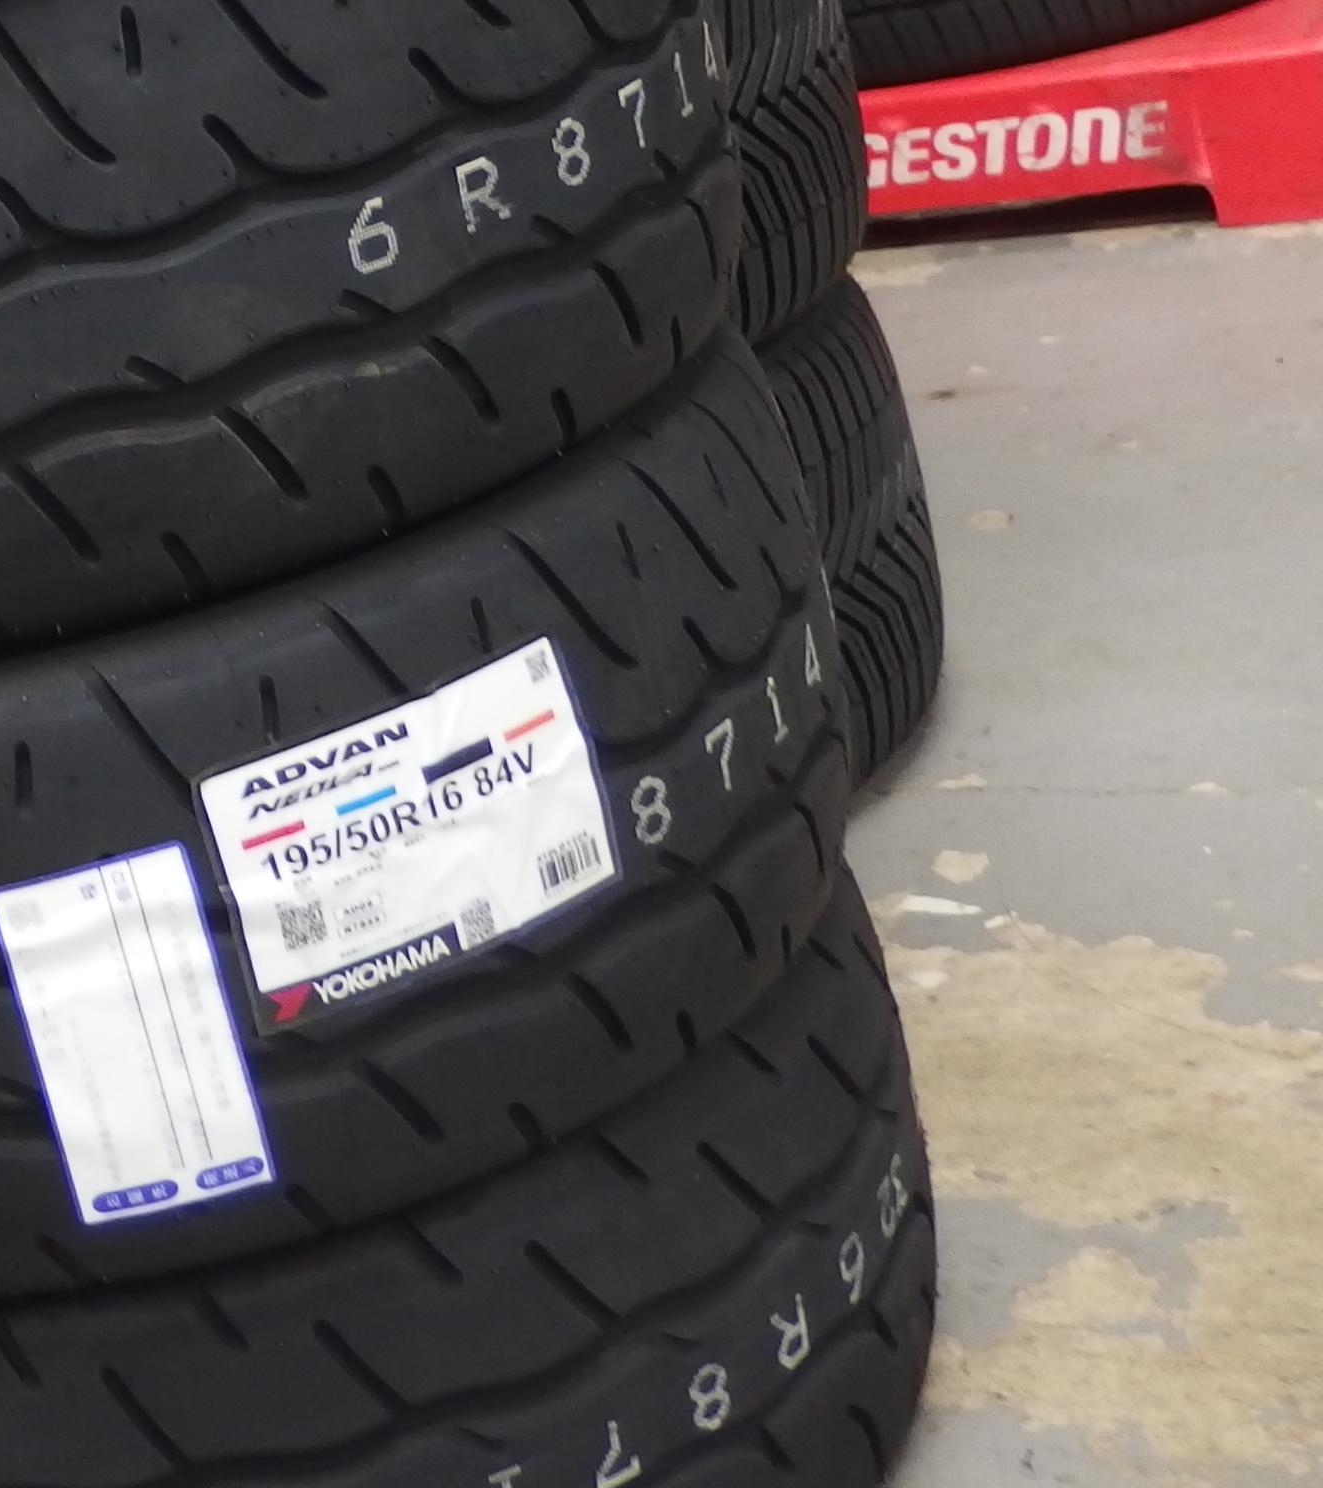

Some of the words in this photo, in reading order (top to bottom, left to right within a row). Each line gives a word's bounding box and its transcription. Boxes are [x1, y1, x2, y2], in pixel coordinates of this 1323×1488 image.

[242, 721, 409, 798] ADVAN
[262, 780, 463, 880] 195/50R16
[476, 745, 535, 794] 84V
[314, 937, 450, 1003] YOKOHAMA
